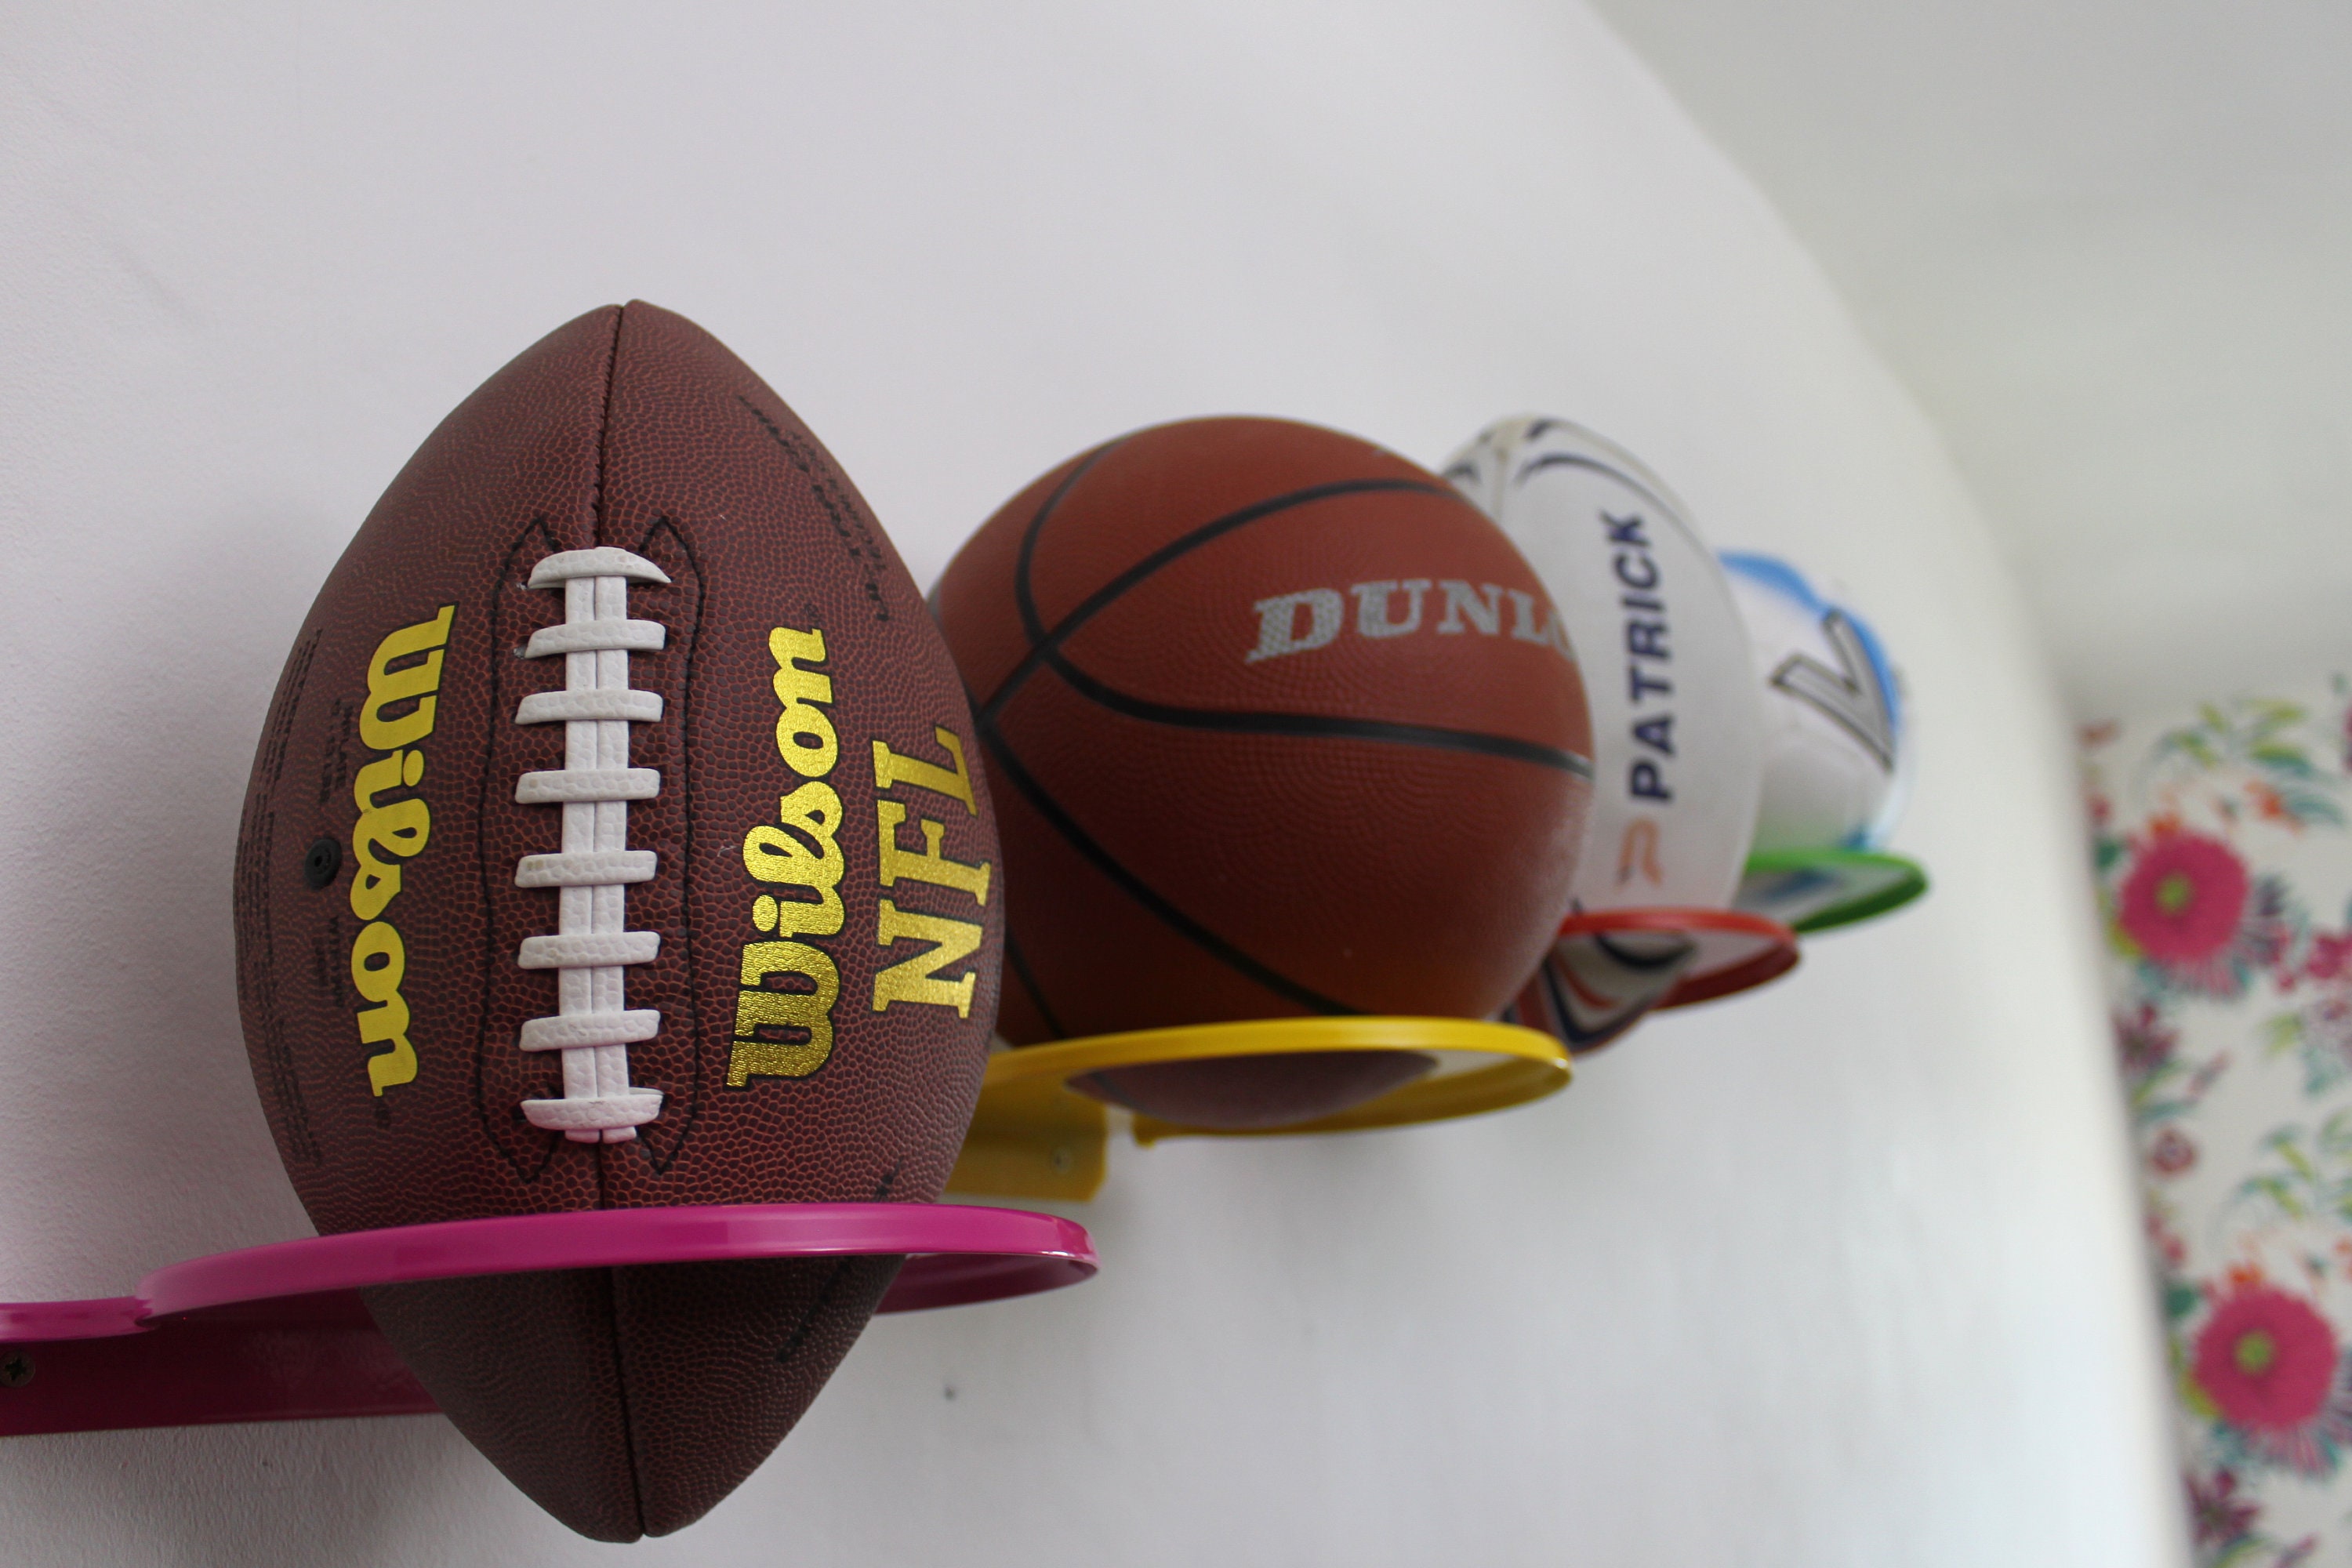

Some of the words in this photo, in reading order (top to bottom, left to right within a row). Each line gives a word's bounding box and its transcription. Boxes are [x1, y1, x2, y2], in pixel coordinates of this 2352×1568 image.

[1600, 510, 1675, 804] PATRICK
[350, 604, 456, 1098] Wilson
[727, 626, 846, 1087] Wilson
[871, 726, 993, 1019] NFL
